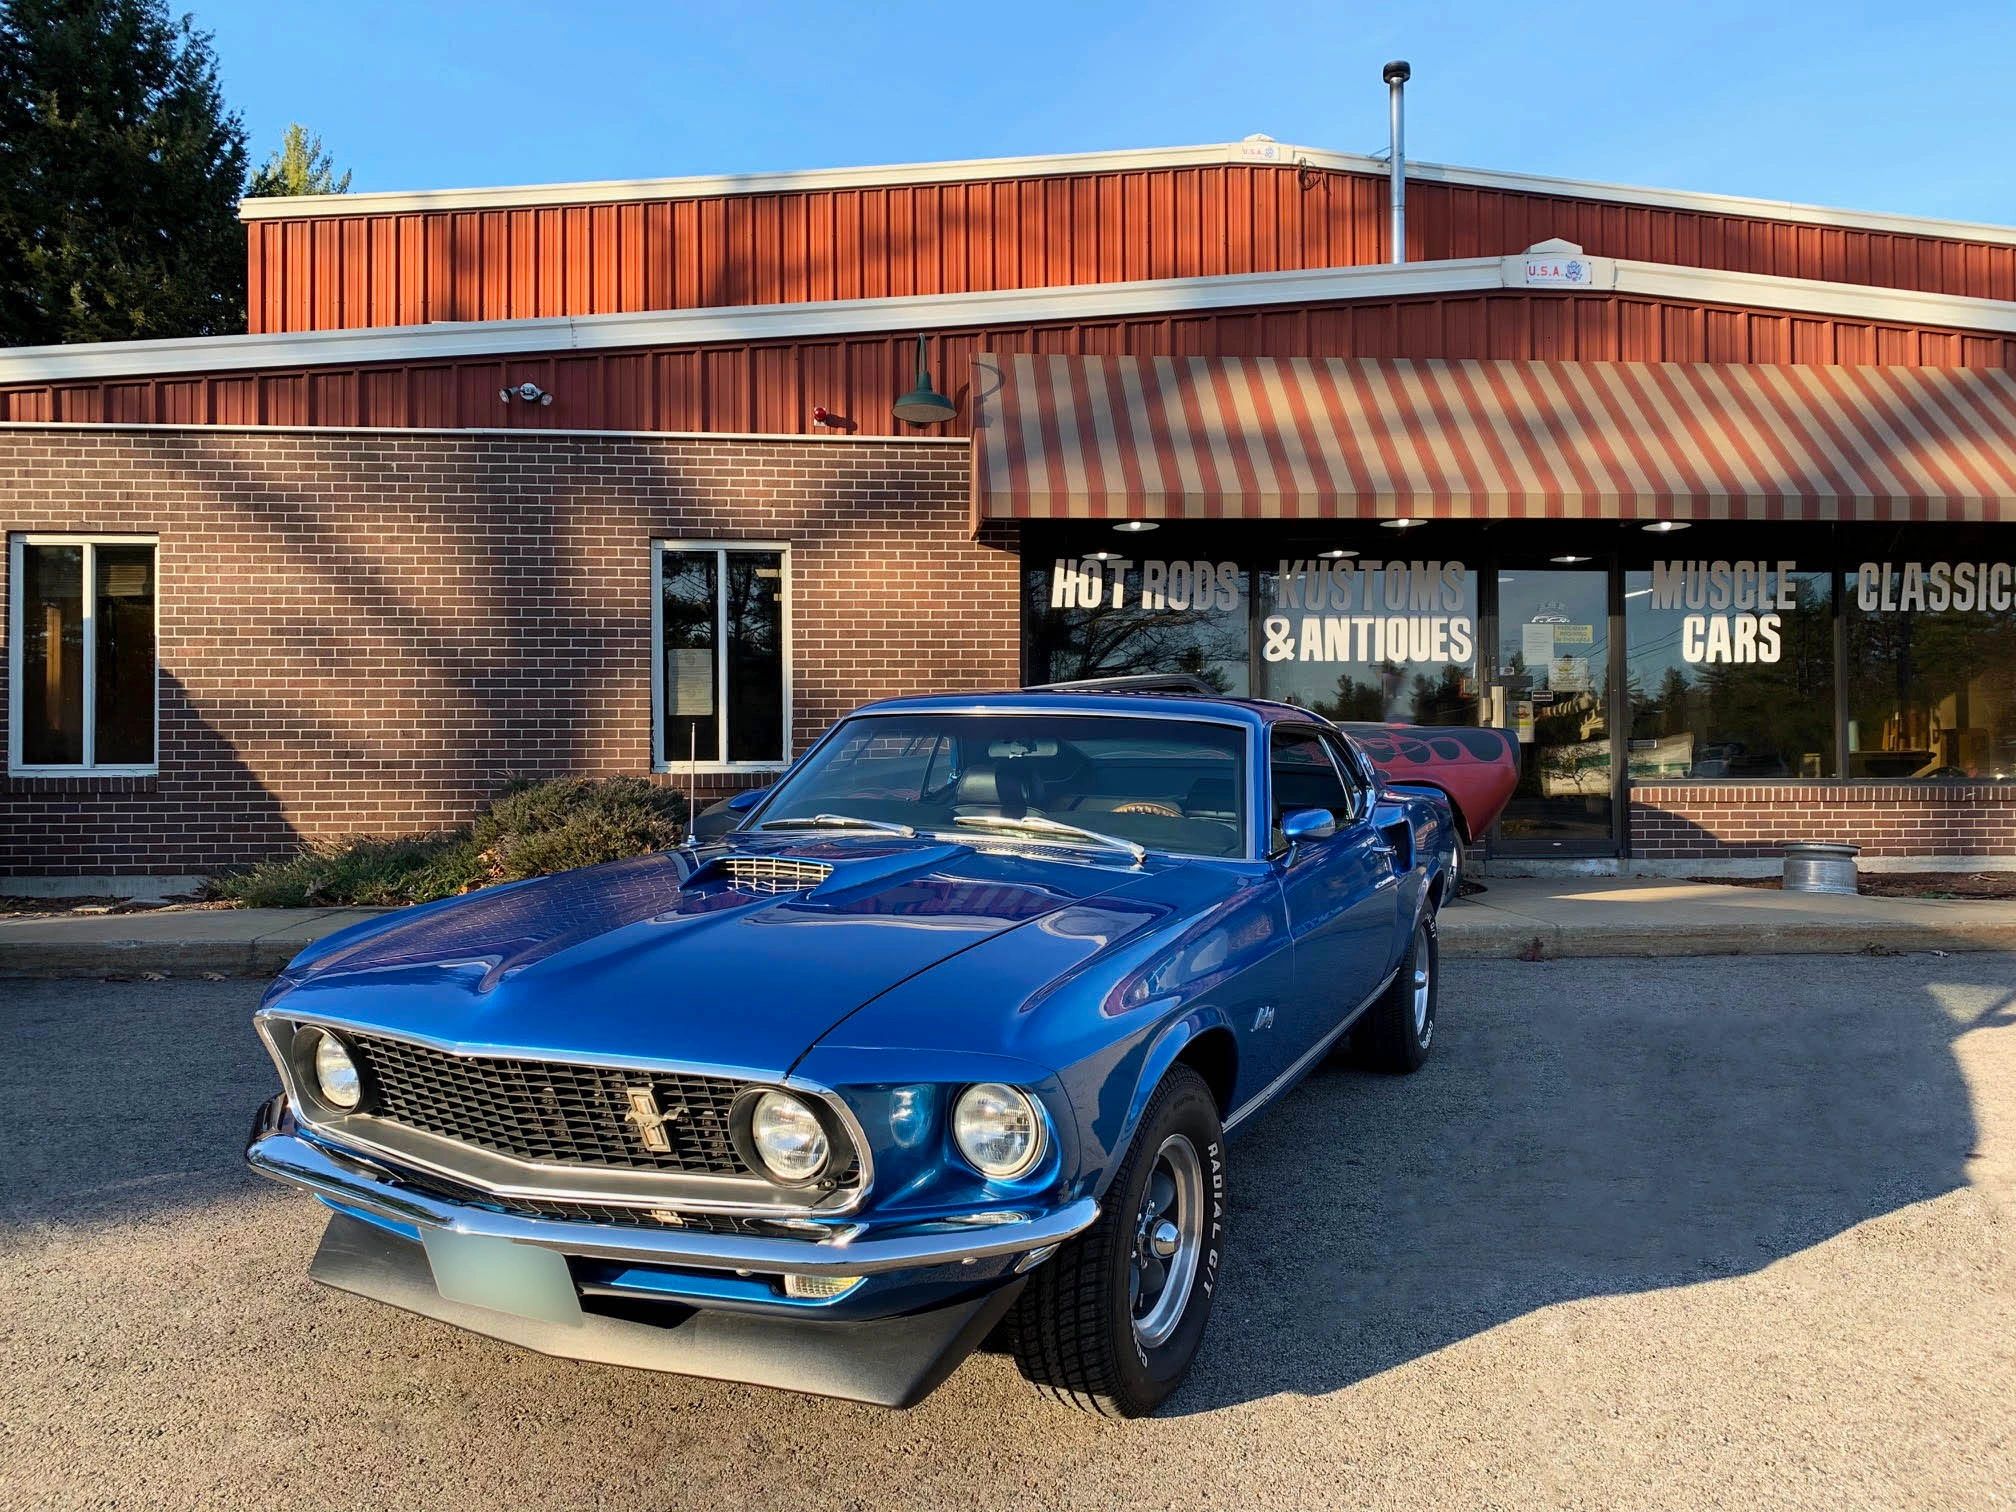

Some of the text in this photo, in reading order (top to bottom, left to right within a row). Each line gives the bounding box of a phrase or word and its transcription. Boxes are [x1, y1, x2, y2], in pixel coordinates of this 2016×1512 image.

[1528, 265, 1564, 277] U.S.A.
[1051, 558, 1239, 612] HOT RODS
[1278, 559, 1466, 612] KUSTOMS
[1651, 560, 1797, 610] MUSCLE
[1857, 562, 2016, 612] CLASSIC
[1682, 614, 1782, 663] CARS
[1203, 1142, 1222, 1299] RADIAL G/T
